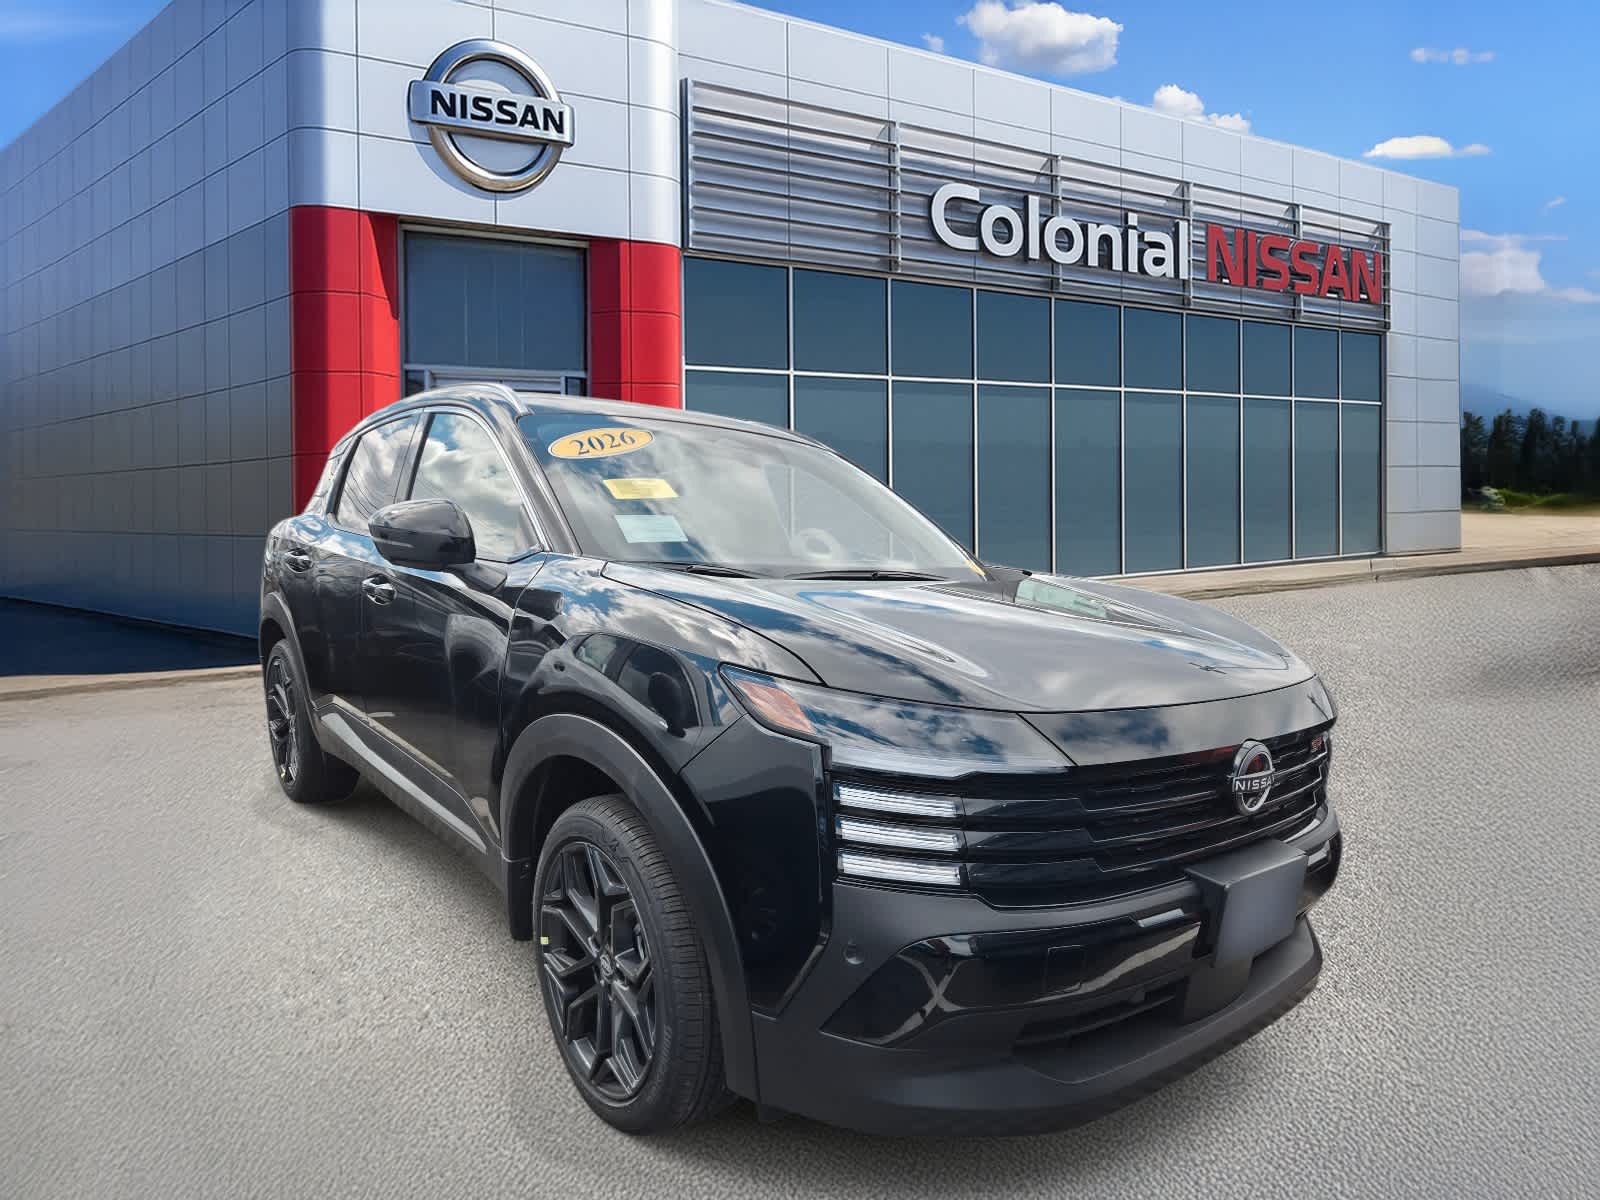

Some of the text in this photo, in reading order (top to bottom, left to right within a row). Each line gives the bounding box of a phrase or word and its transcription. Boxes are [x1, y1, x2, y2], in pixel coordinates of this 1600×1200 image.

[431, 89, 564, 134] NISSAN
[929, 183, 1383, 304] Colonial NISSAN
[570, 431, 636, 455] 2026
